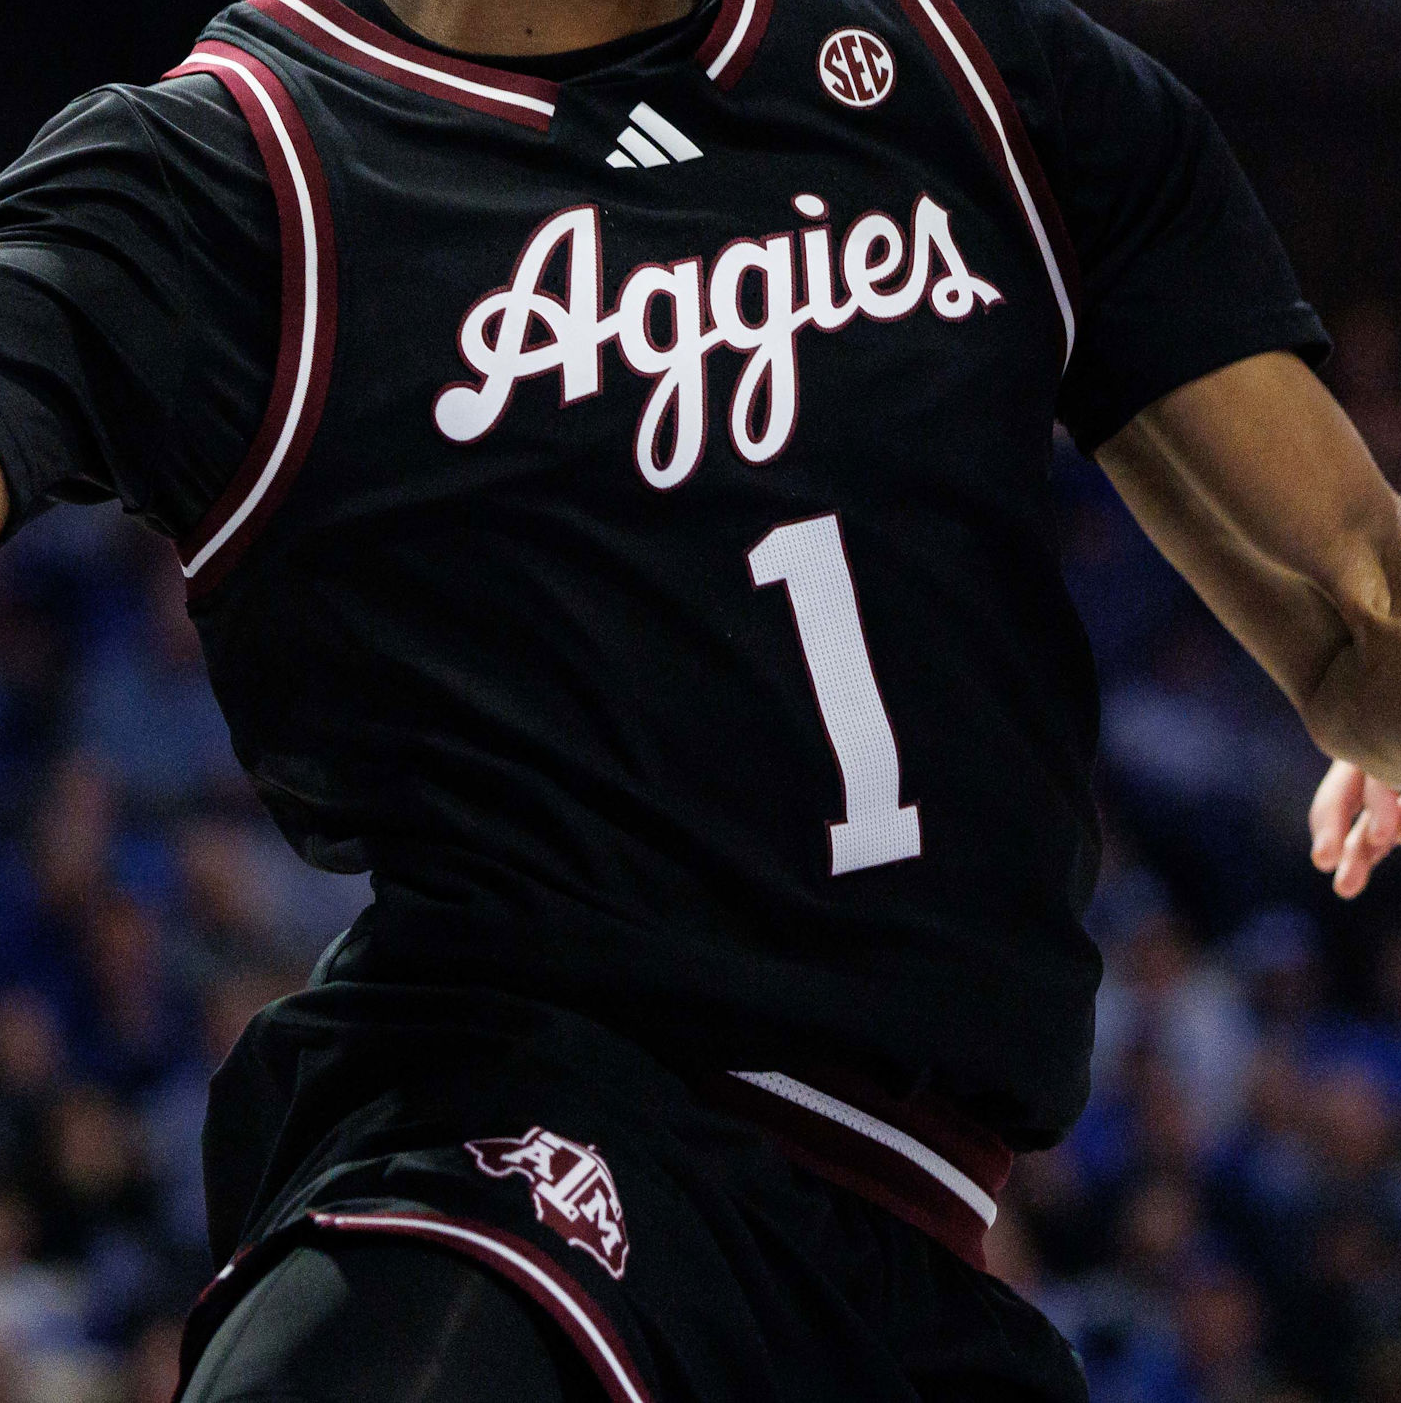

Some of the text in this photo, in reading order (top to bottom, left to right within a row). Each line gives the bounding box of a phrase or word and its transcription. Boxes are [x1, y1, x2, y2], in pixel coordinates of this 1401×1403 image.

[823, 34, 890, 102] SEC
[434, 192, 1004, 491] Aggies
[744, 510, 924, 877] 1
